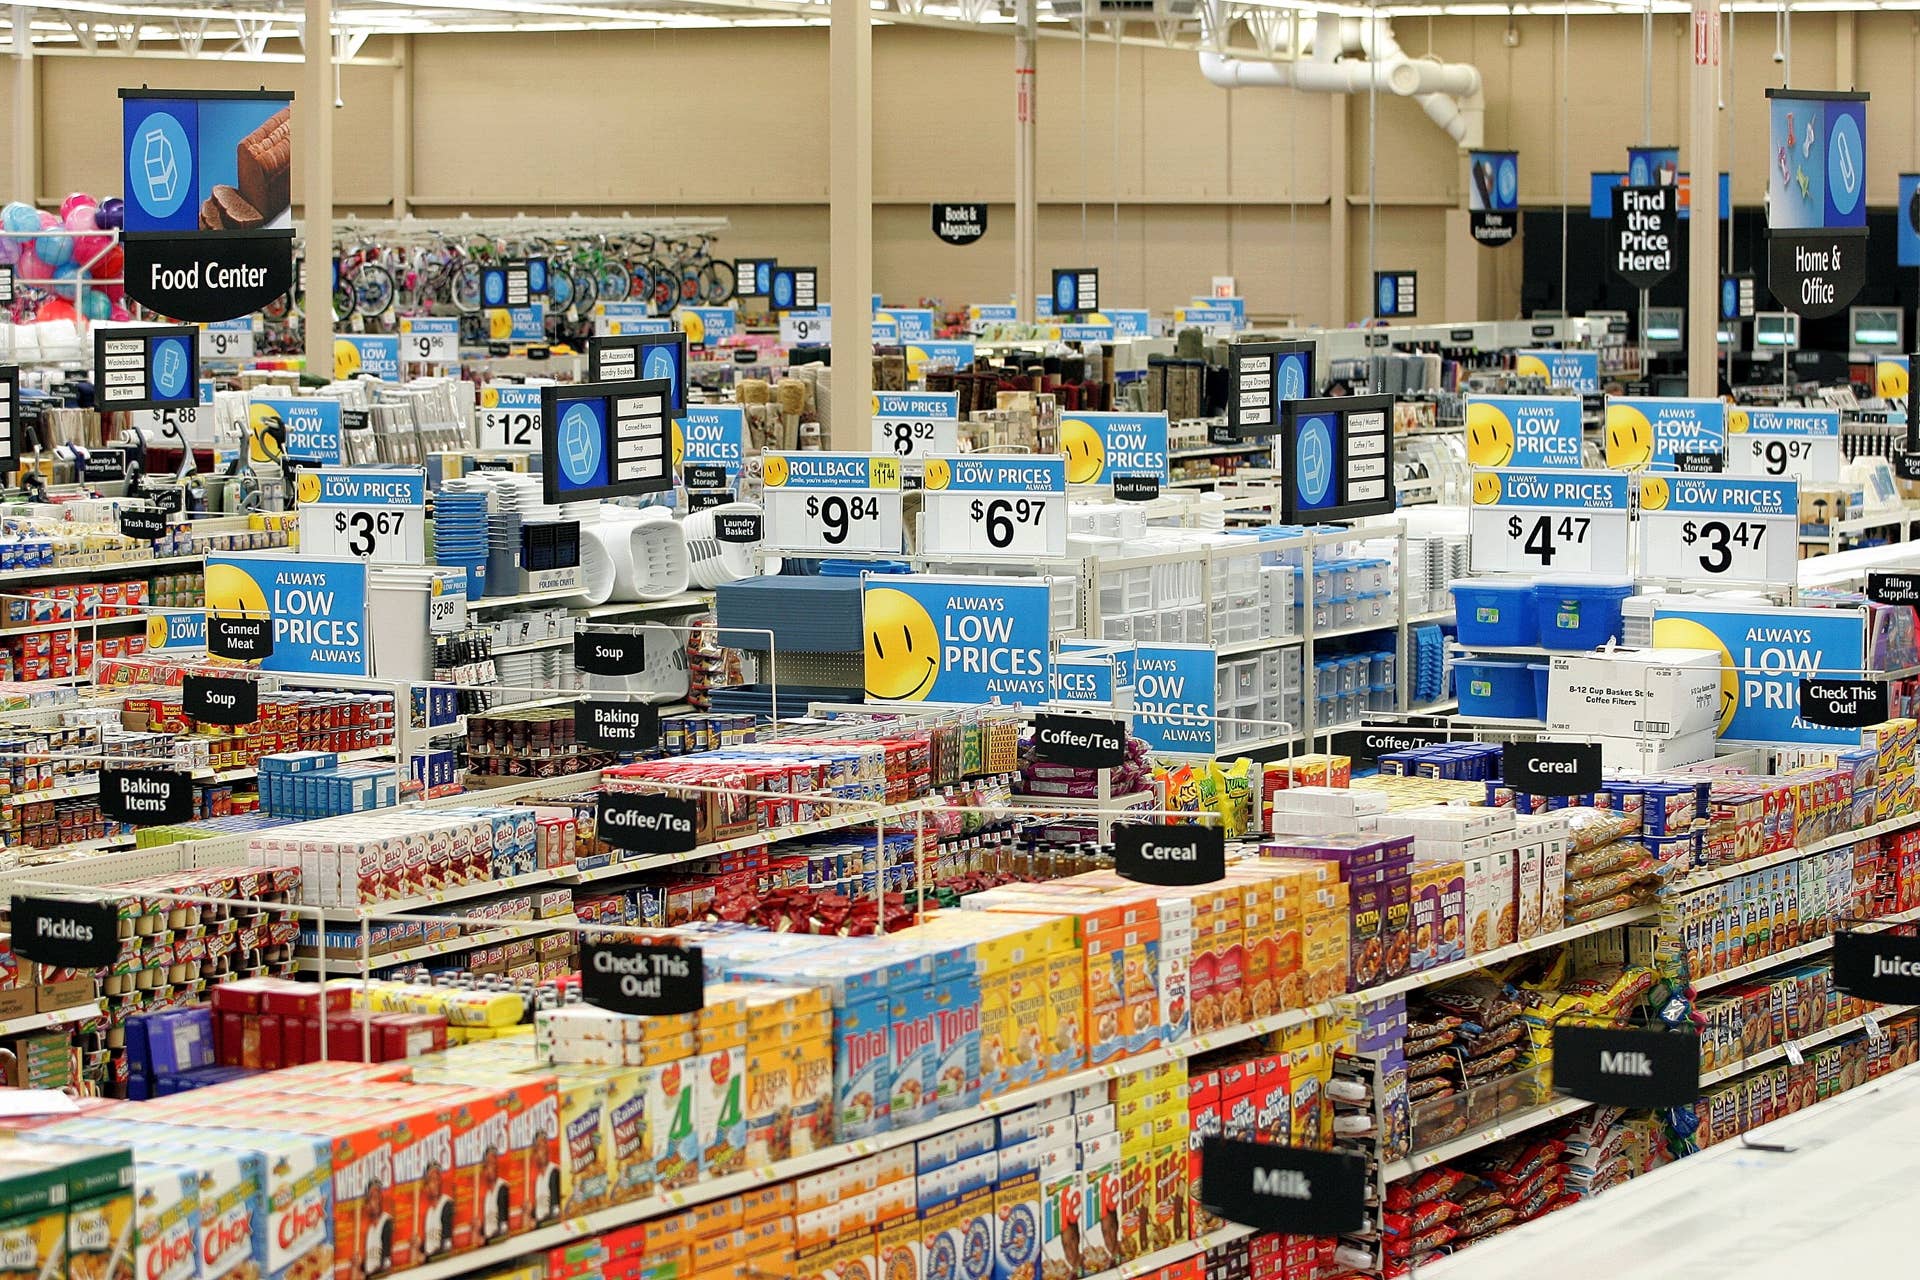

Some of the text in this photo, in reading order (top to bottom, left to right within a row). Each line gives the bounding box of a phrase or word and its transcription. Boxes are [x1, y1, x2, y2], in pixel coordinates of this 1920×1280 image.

[1622, 190, 1665, 211] Find
[945, 206, 977, 221] Books &
[1485, 213, 1502, 225] Home
[1628, 209, 1661, 231] the
[940, 221, 981, 239] Magazines
[1620, 231, 1668, 250] Price
[1618, 250, 1671, 272] Here!
[1795, 245, 1841, 272] Home &
[151, 260, 267, 290] Food Center
[1802, 278, 1834, 305] Office
[512, 312, 534, 323] LOW
[704, 317, 727, 328] LOW
[512, 321, 542, 331] PRICES
[622, 322, 664, 333] LOW PRICES
[704, 326, 734, 336] PRICES
[361, 349, 387, 360] LOW
[361, 360, 397, 372] PRICES
[1552, 365, 1583, 379] LOW
[501, 392, 525, 404] LOW
[883, 401, 948, 413] LOW PRICES
[1518, 407, 1554, 416] ALWAYS
[1658, 409, 1695, 418] ALWAYS
[288, 416, 323, 433] LOW
[687, 415, 719, 424] ALWAYS
[1107, 423, 1142, 432] ALWAYS
[1516, 419, 1559, 435] LOW
[1753, 417, 1828, 431] LOW PRICES
[686, 426, 723, 441] LOW
[1657, 420, 1701, 437] LOW
[289, 434, 337, 449] PRICES
[1106, 434, 1147, 450] LOW
[1516, 437, 1578, 454] PRICES
[686, 442, 739, 458] PRICES
[1106, 452, 1163, 468] PRICES
[1542, 455, 1578, 464] ALWAYS
[1686, 456, 1710, 464] Plastic
[694, 469, 716, 478] Closet
[790, 461, 865, 477] ROLLBACK
[956, 468, 1051, 484] LOW PRICES
[1683, 463, 1713, 473] Storage
[326, 475, 350, 483] ALWAYS
[692, 477, 719, 487] Storage
[1508, 475, 1537, 483] ALWAYS
[1676, 480, 1705, 488] ALWAYS
[326, 482, 411, 498] LOW PRICES
[1115, 484, 1158, 493] Shelf Liners
[1507, 483, 1613, 500] LOW PRICES
[703, 496, 718, 505] Sink
[1583, 500, 1613, 508] ALWAYS
[1675, 488, 1782, 506] LOW PRICES
[124, 518, 163, 530] Trash Bags
[723, 518, 755, 529] Laundry
[725, 526, 754, 536] Baskets
[275, 572, 326, 586] ALWAYS
[1885, 578, 1912, 590] Filing
[1878, 588, 1919, 601] Supplies
[274, 590, 334, 617] LOW
[946, 597, 1004, 611] ALWAYS
[171, 623, 199, 638] LOW
[220, 623, 260, 636] Canned
[274, 617, 360, 647] PRICES
[945, 615, 1015, 643] LOW
[1745, 628, 1811, 644] ALWAYS
[227, 637, 254, 650] Meat
[310, 649, 361, 663] ALWAYS
[595, 645, 624, 661] Soup
[945, 646, 1043, 675] PRICES
[1745, 647, 1822, 676] LOW
[986, 679, 1044, 693] ALWAYS
[1569, 685, 1654, 698] 8-12 Cup Basket Stle
[1810, 685, 1877, 700] Check This
[205, 690, 236, 707] Soup
[1066, 691, 1097, 699] ALWAYS
[1586, 696, 1637, 706] Coffee Filters
[1829, 700, 1857, 714] Out!
[594, 708, 640, 727] Baking
[598, 723, 636, 739] Items
[1040, 728, 1119, 750] Coffee/Tea
[1162, 729, 1211, 743] ALWAYS
[1527, 758, 1578, 774] Cereal
[120, 777, 171, 800] Baking
[125, 796, 166, 812] Items
[603, 808, 692, 833] Coffee/Tea
[1140, 843, 1198, 862] Cereal
[1413, 898, 1436, 915] RAISIN
[1440, 890, 1463, 907] RAISIN
[1416, 910, 1435, 925] BRAN
[1442, 902, 1462, 917] BRAN
[1355, 909, 1380, 927] EXTRA
[36, 916, 94, 942] Pickles
[593, 951, 690, 977] Check This
[620, 975, 661, 998] Out!
[937, 1002, 980, 1052] Total
[892, 1014, 934, 1064] Total
[845, 1025, 887, 1078] Total
[1600, 1050, 1652, 1077] Milk
[509, 1094, 558, 1150] WHEATIES
[454, 1109, 509, 1168] WHEATIES
[393, 1125, 452, 1185] WHEATIES
[336, 1142, 393, 1201] WHEATIES
[1253, 1167, 1313, 1201] Milk
[1085, 1170, 1121, 1231] life
[1044, 1185, 1082, 1244] life
[278, 1196, 326, 1250] Chex
[204, 1208, 253, 1266] Chex
[147, 1228, 195, 1280] Chex
